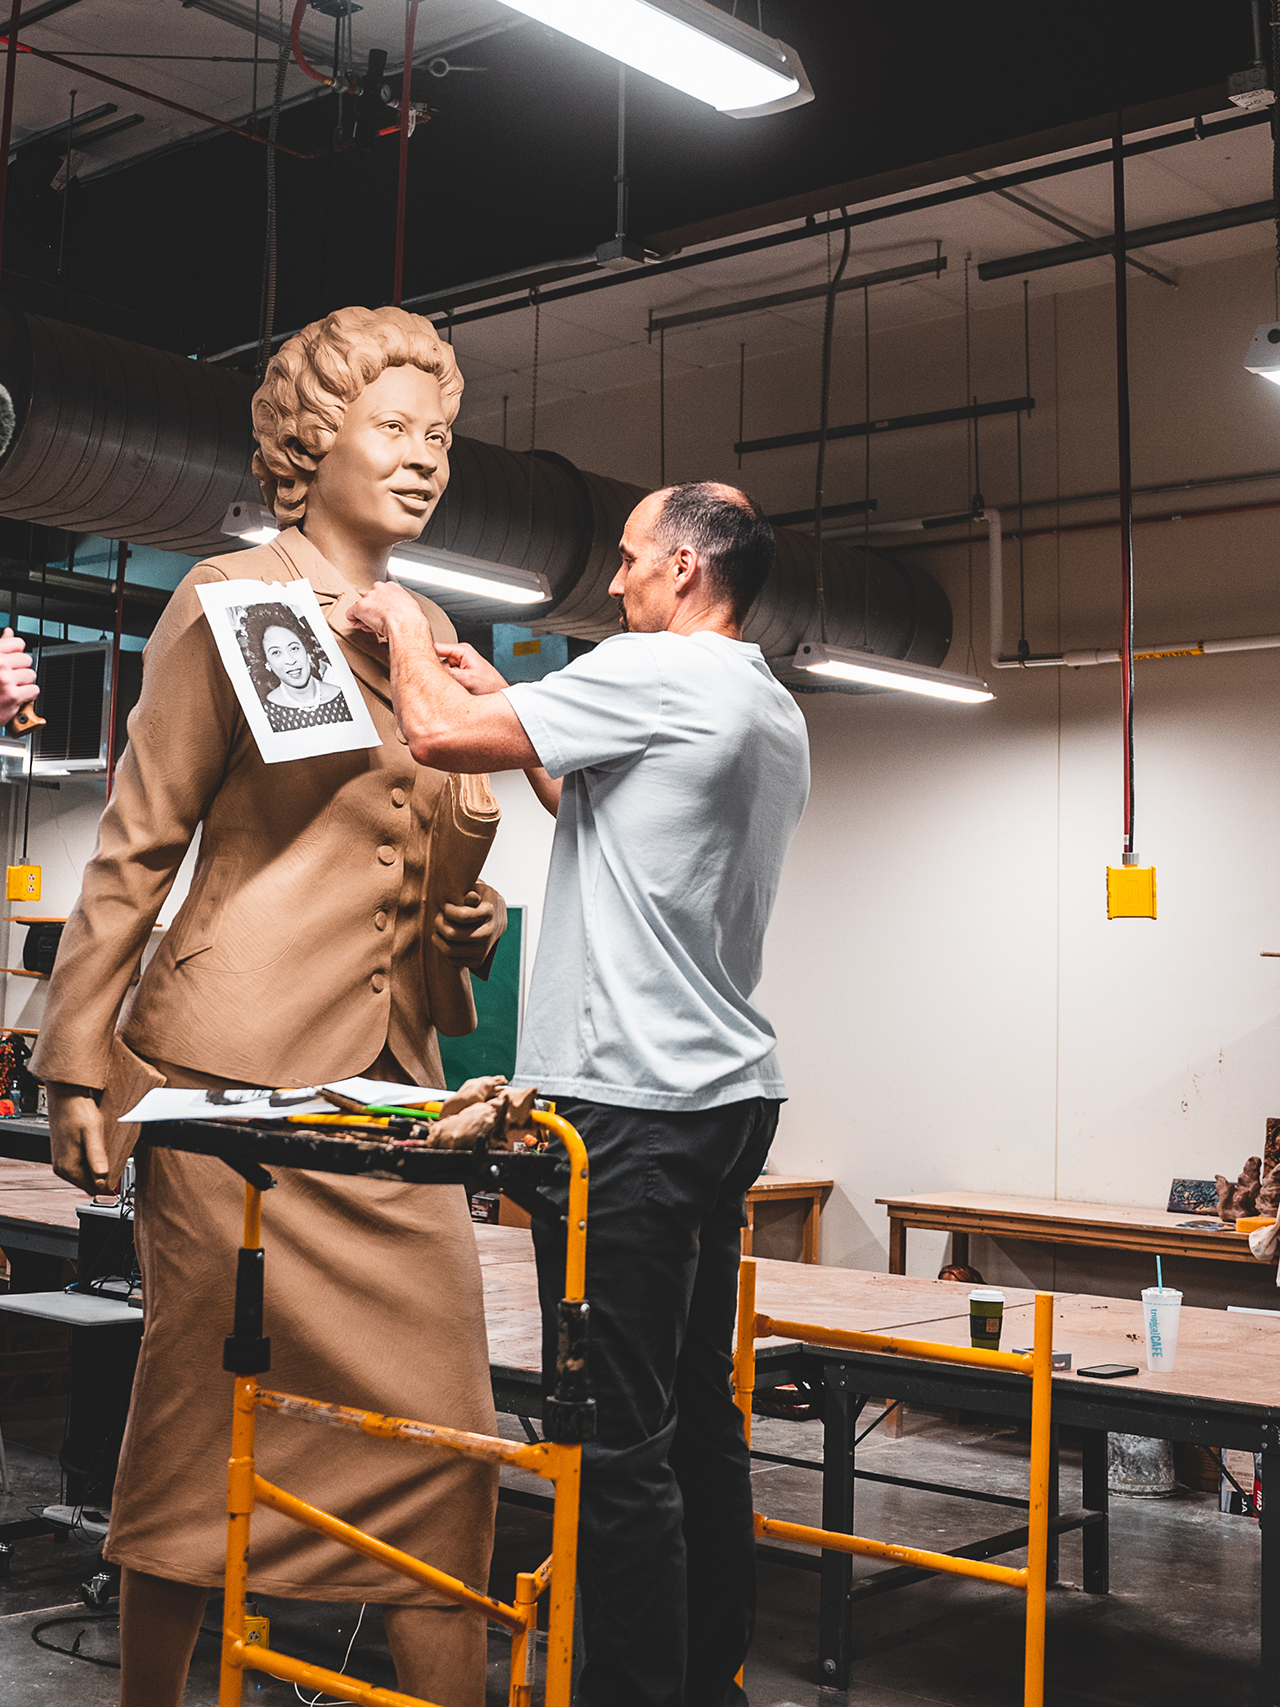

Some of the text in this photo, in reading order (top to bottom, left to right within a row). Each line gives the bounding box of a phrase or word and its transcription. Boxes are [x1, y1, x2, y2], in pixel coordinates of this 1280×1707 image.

[1245, 99, 1261, 107] 20
[1150, 1308, 1163, 1358] tropical CAFE
